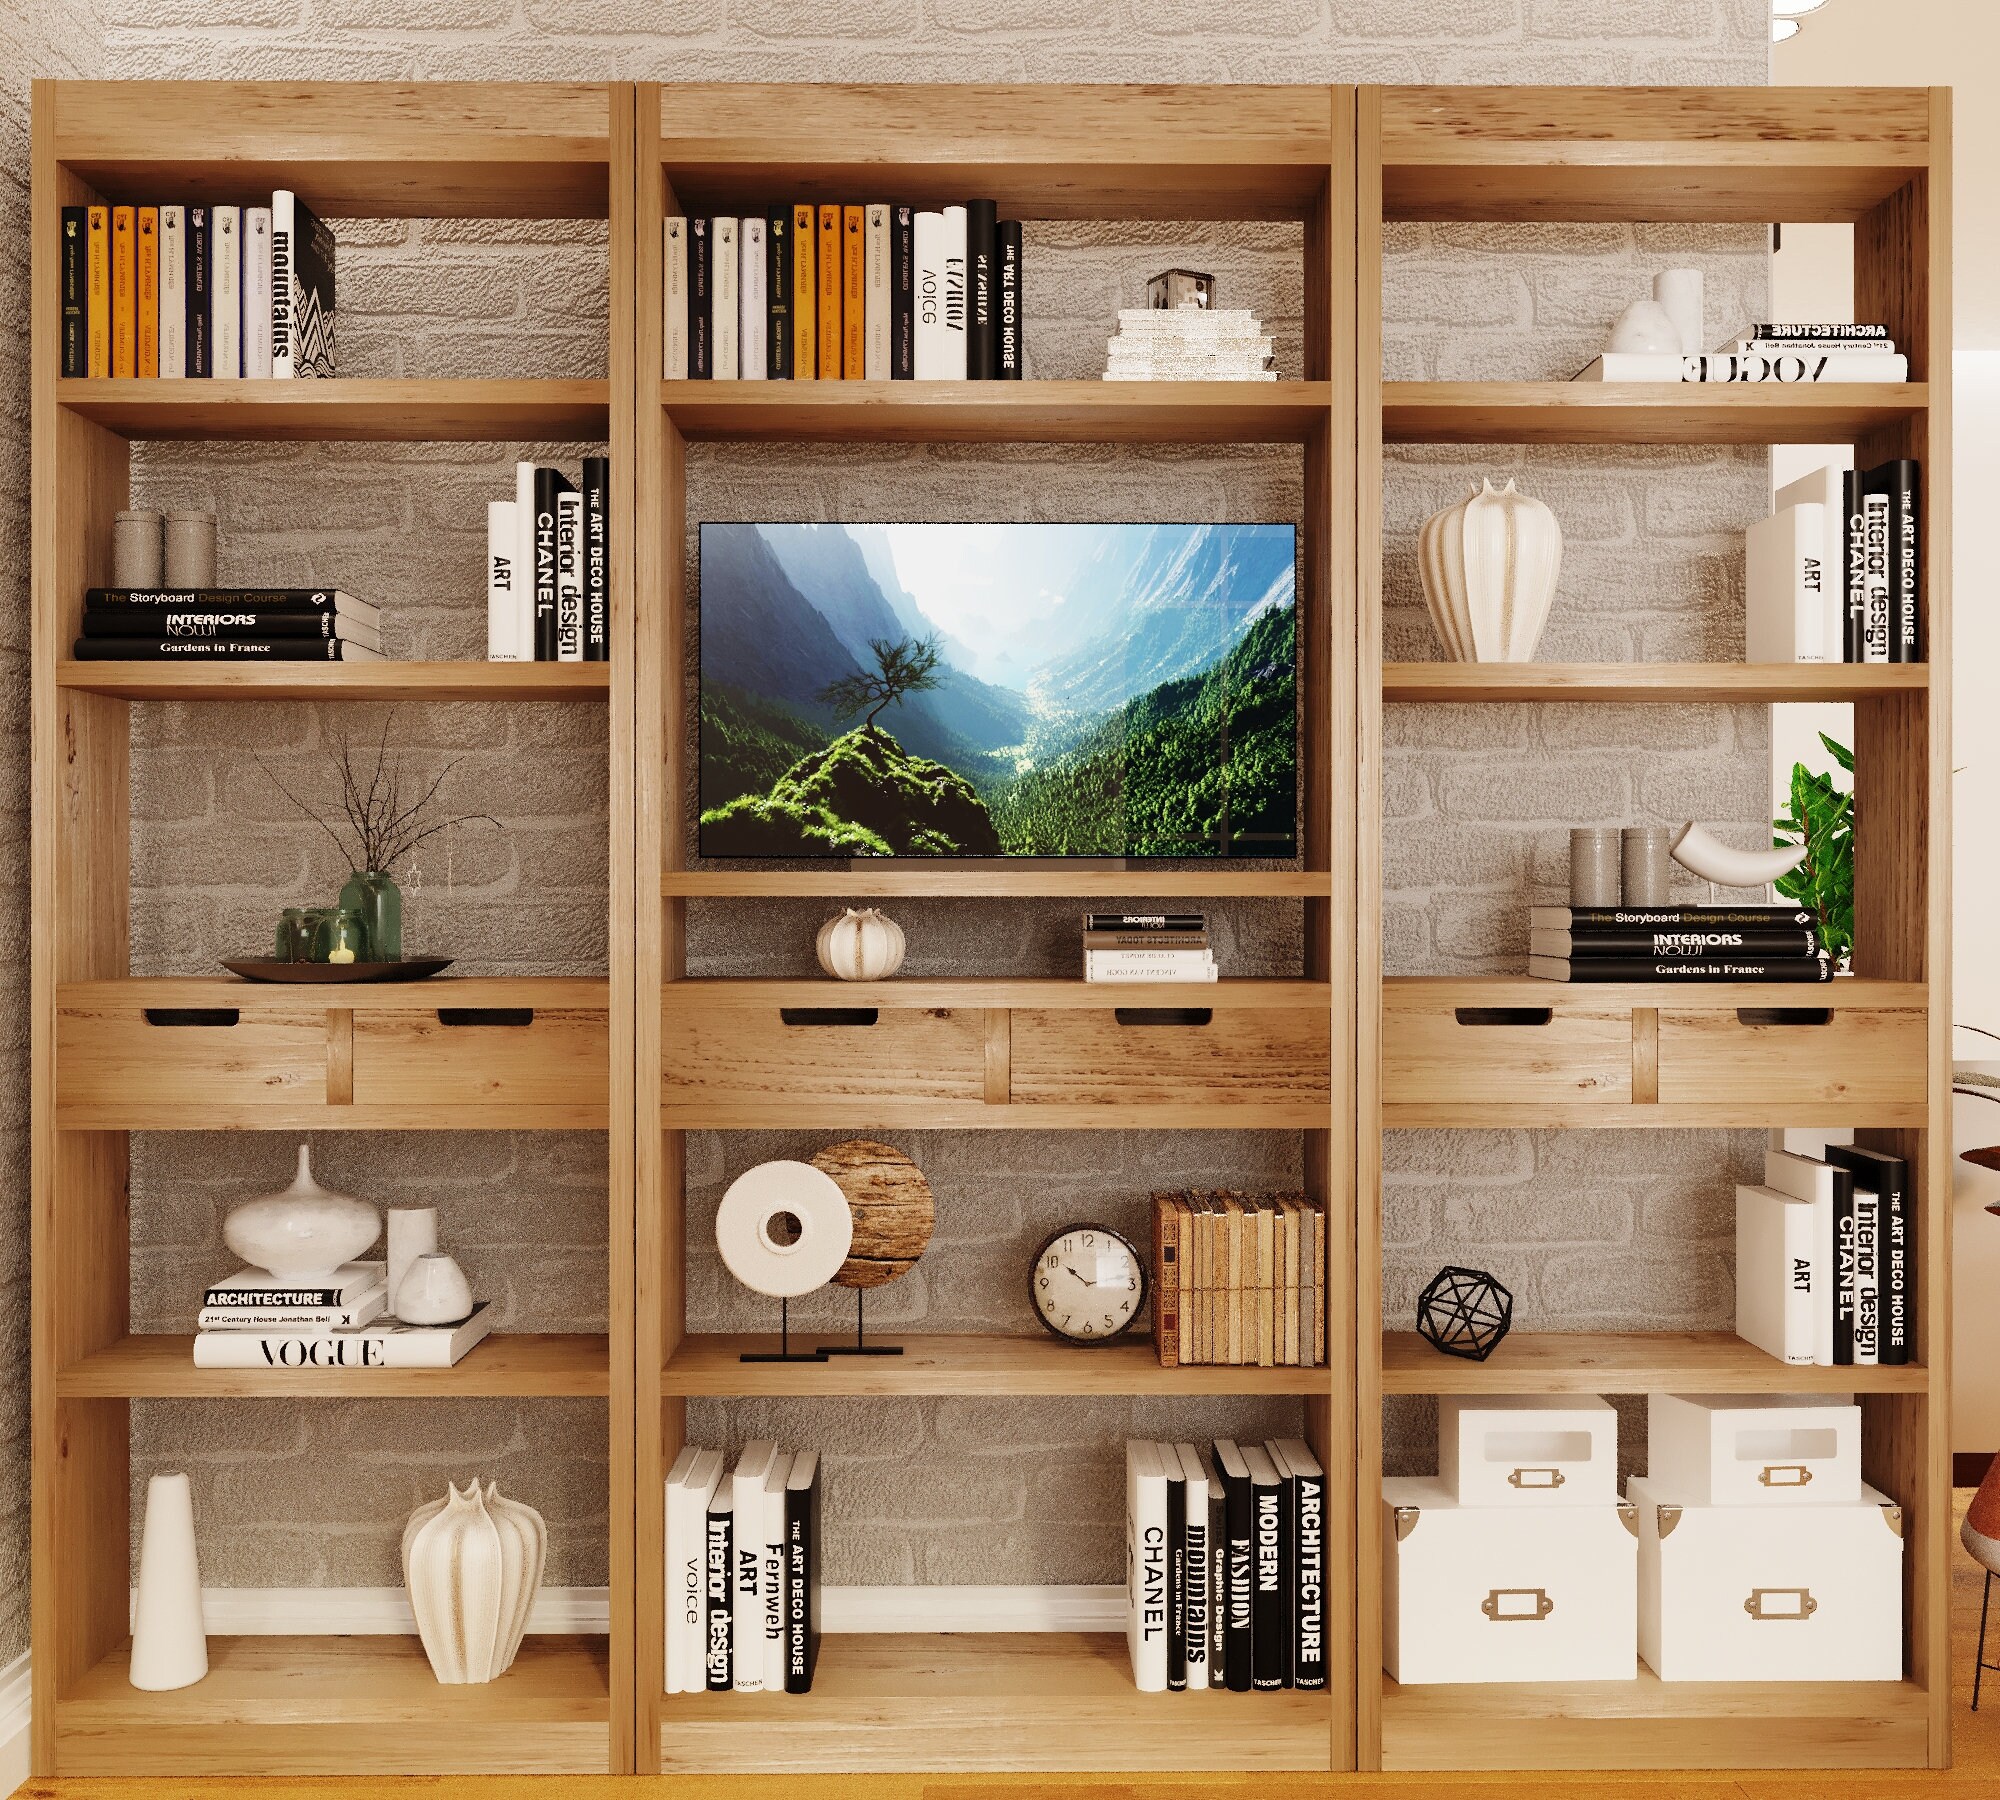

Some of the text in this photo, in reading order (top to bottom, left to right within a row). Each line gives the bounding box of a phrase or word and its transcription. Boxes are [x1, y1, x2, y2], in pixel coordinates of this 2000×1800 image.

[273, 232, 292, 358] mountains
[494, 556, 511, 591] ART
[538, 513, 553, 618] CHANEL
[558, 501, 582, 655] Interior design
[591, 488, 603, 644] THE ART DECO HOUSE
[1804, 558, 1820, 592] ART
[1850, 514, 1864, 619] CHANEL
[1866, 503, 1888, 656] Interior design
[1902, 490, 1914, 645] THE ART DECO HOUSE
[104, 593, 287, 604] The Storyboard Design Course
[167, 615, 256, 625] INTERIORS
[160, 643, 270, 652] Gardens in France
[1590, 912, 1770, 923] The Storyboard Design Course
[1653, 935, 1742, 945] INTERIORS
[1653, 945, 1702, 955] NOW!
[1656, 965, 1764, 974] Gardens in France
[1064, 1240, 1071, 1252] 11
[1082, 1234, 1093, 1247] 12
[1047, 1256, 1058, 1268] 10
[1121, 1256, 1128, 1268] 2
[1794, 1259, 1810, 1293] ART
[1840, 1217, 1853, 1320] CHANEL
[1891, 1192, 1903, 1345] THE ART DECO HOUSE
[1040, 1278, 1049, 1289] 9
[1128, 1278, 1135, 1290] 3
[1855, 1203, 1878, 1356] Interior design
[207, 1293, 322, 1305] ARCHITECTURE
[1047, 1300, 1054, 1311] 8
[1120, 1301, 1129, 1312] 4
[222, 1316, 252, 1324] Century
[1062, 1315, 1071, 1328] 7
[1084, 1321, 1092, 1333] 6
[1105, 1315, 1113, 1328] 5
[259, 1340, 384, 1366] VOGUE
[793, 1545, 804, 1574] ART
[1259, 1495, 1278, 1591] MODERN
[740, 1550, 757, 1597] ART
[1145, 1527, 1164, 1642] CHANEL
[1214, 1549, 1224, 1602] Graphic
[1232, 1539, 1249, 1629] FASHION
[1302, 1481, 1320, 1662] ARCHITECTURE
[687, 1559, 701, 1624] voice
[707, 1520, 732, 1684] Interior design
[766, 1544, 784, 1640] Fernweh
[793, 1579, 804, 1619] DECO
[1188, 1525, 1207, 1664] mountains
[1214, 1605, 1224, 1651] Design
[793, 1624, 804, 1675] HOUSE
